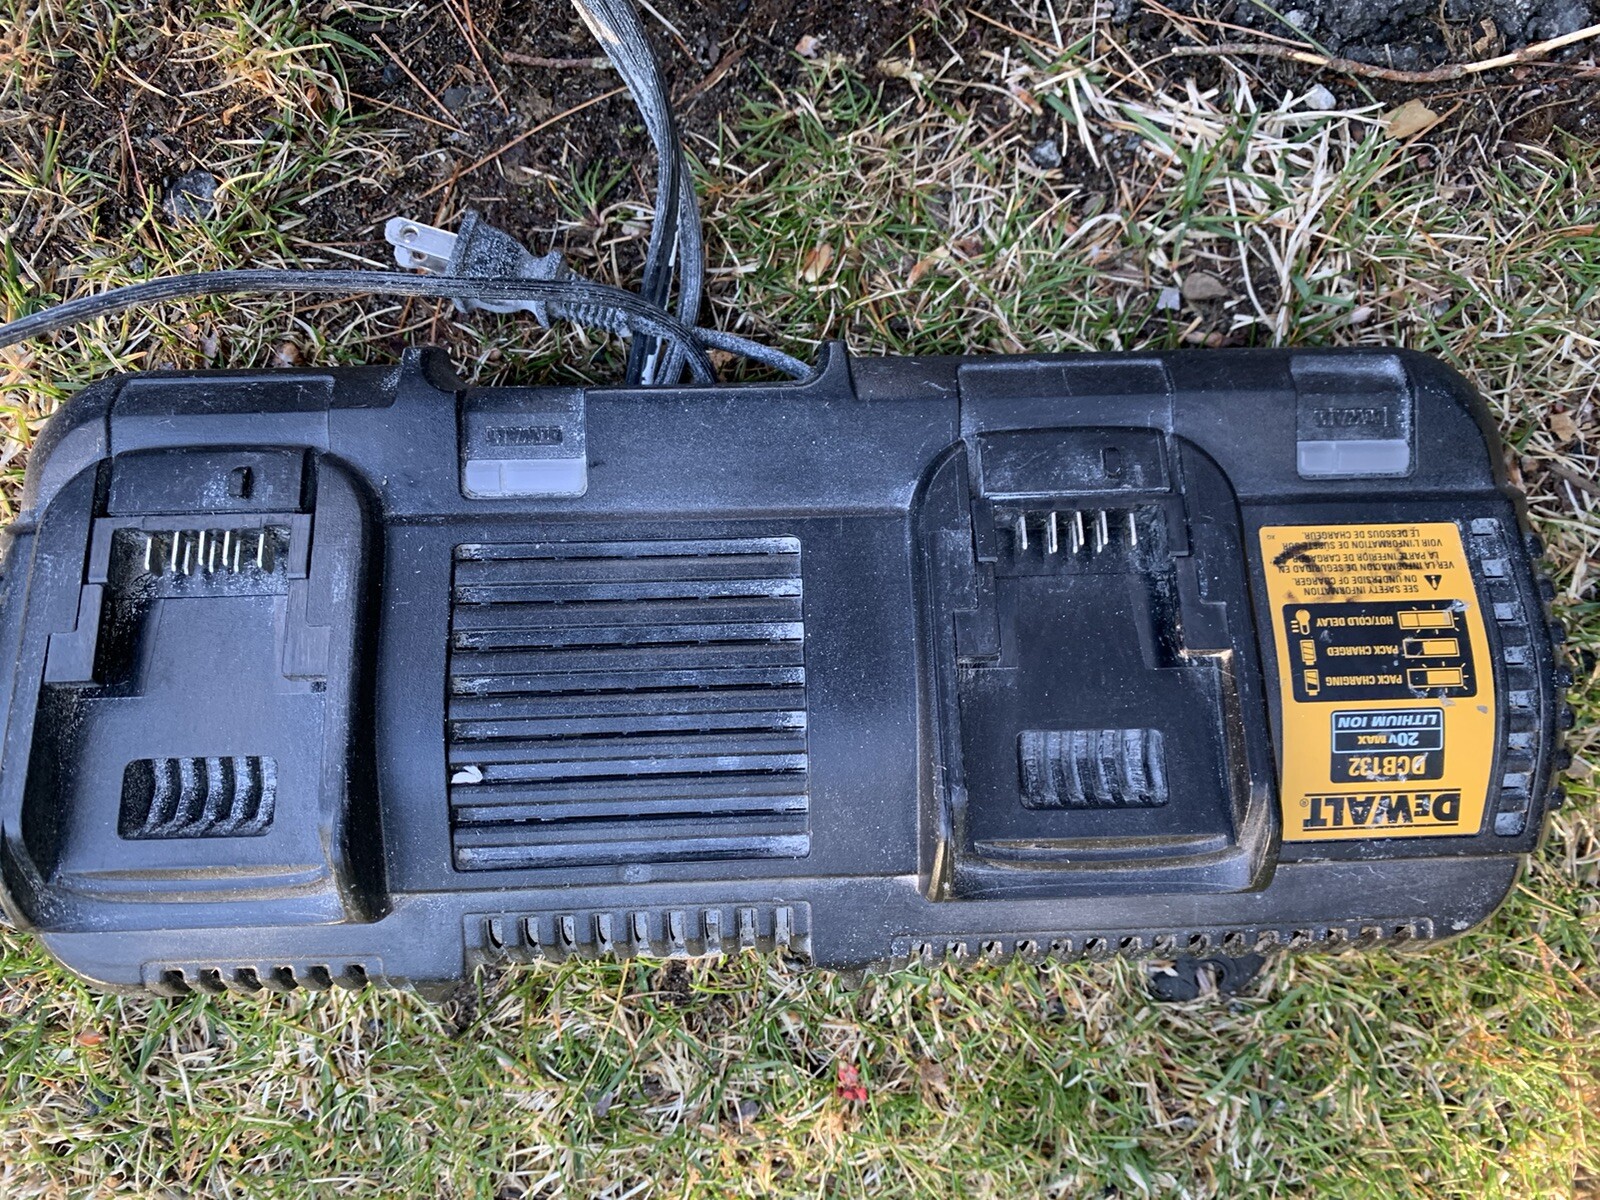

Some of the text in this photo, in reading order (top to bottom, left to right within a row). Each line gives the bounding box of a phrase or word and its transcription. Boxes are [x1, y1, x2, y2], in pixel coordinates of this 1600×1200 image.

[1302, 529, 1420, 540] LE DESSOUS DE CHARGEUR.
[1338, 541, 1349, 549] DE
[1352, 539, 1420, 549] L'INFORMATION
[1421, 539, 1443, 547] VOIR
[1292, 551, 1439, 563] LA PARTE INFERIOR DE CARGAOR
[1278, 565, 1290, 573] EN
[1292, 564, 1344, 573] SEGURIDAD
[1346, 563, 1358, 572] DE
[1424, 561, 1436, 570] LA
[1438, 561, 1455, 569] VER
[1339, 576, 1350, 585] OF
[1351, 575, 1401, 584] UNDERSIDE
[1404, 574, 1417, 583] ON
[1303, 584, 1419, 596] SEE SAFETY INFORMATION
[1316, 615, 1394, 627] HOT/COLD DELAY
[1327, 645, 1399, 657] PACK CHARGED
[1325, 674, 1402, 687] PACK CHARGING
[1338, 714, 1438, 728] LITHIUM ION
[1357, 734, 1388, 745] MAX
[1349, 755, 1426, 777] DCB132
[1303, 793, 1461, 828] DEWALT
